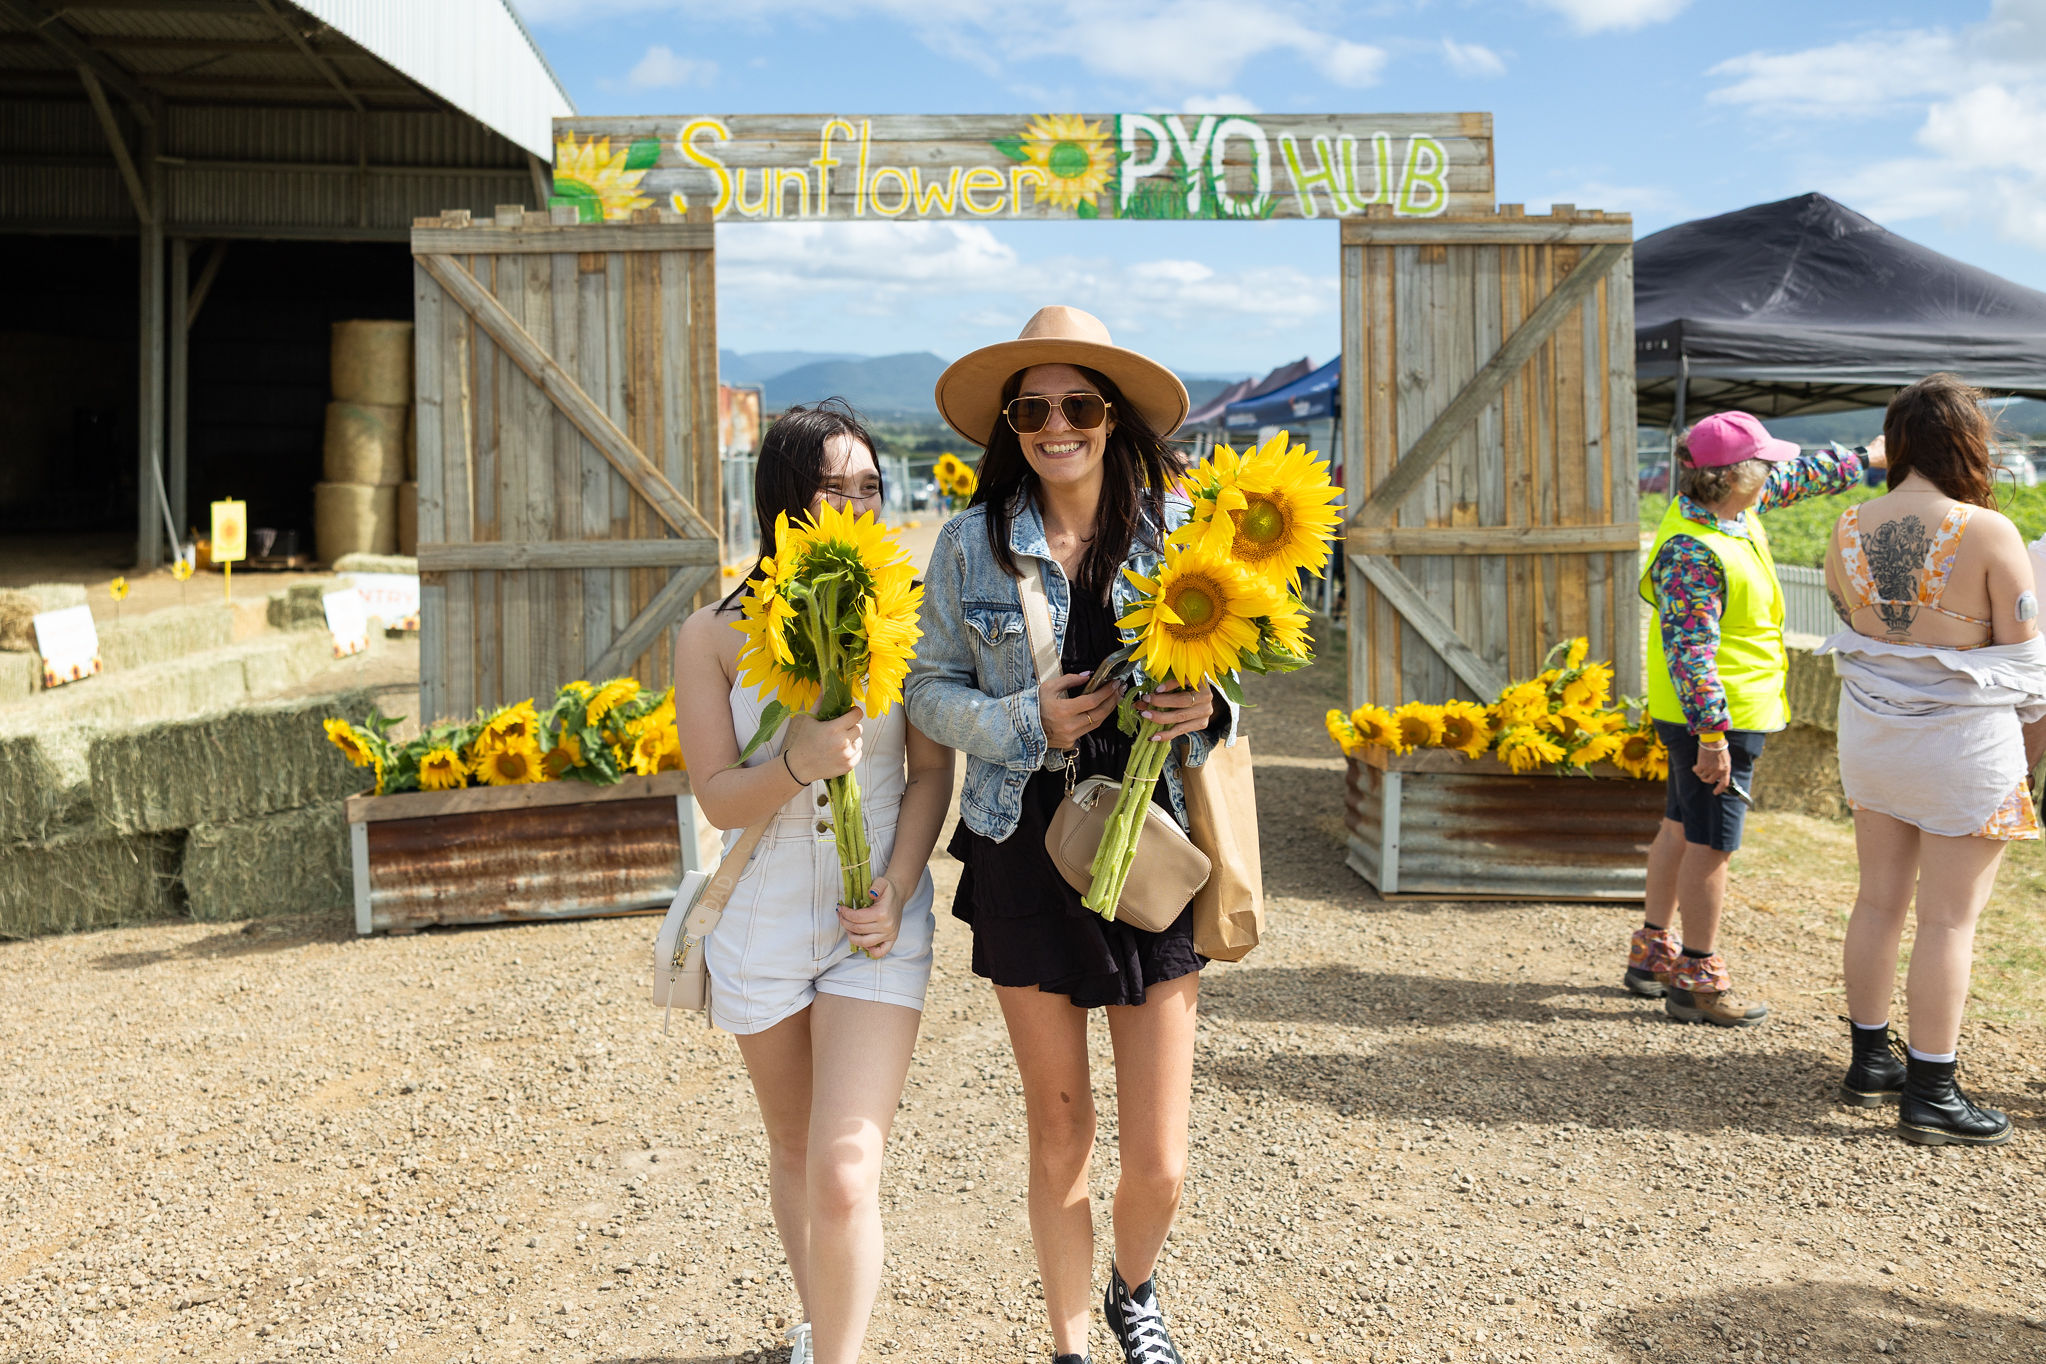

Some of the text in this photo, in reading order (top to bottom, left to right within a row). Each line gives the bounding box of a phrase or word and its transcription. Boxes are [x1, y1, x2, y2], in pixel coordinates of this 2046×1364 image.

[670, 113, 1450, 219] Sunflower PYO HUB
[357, 587, 417, 605] NTRY
